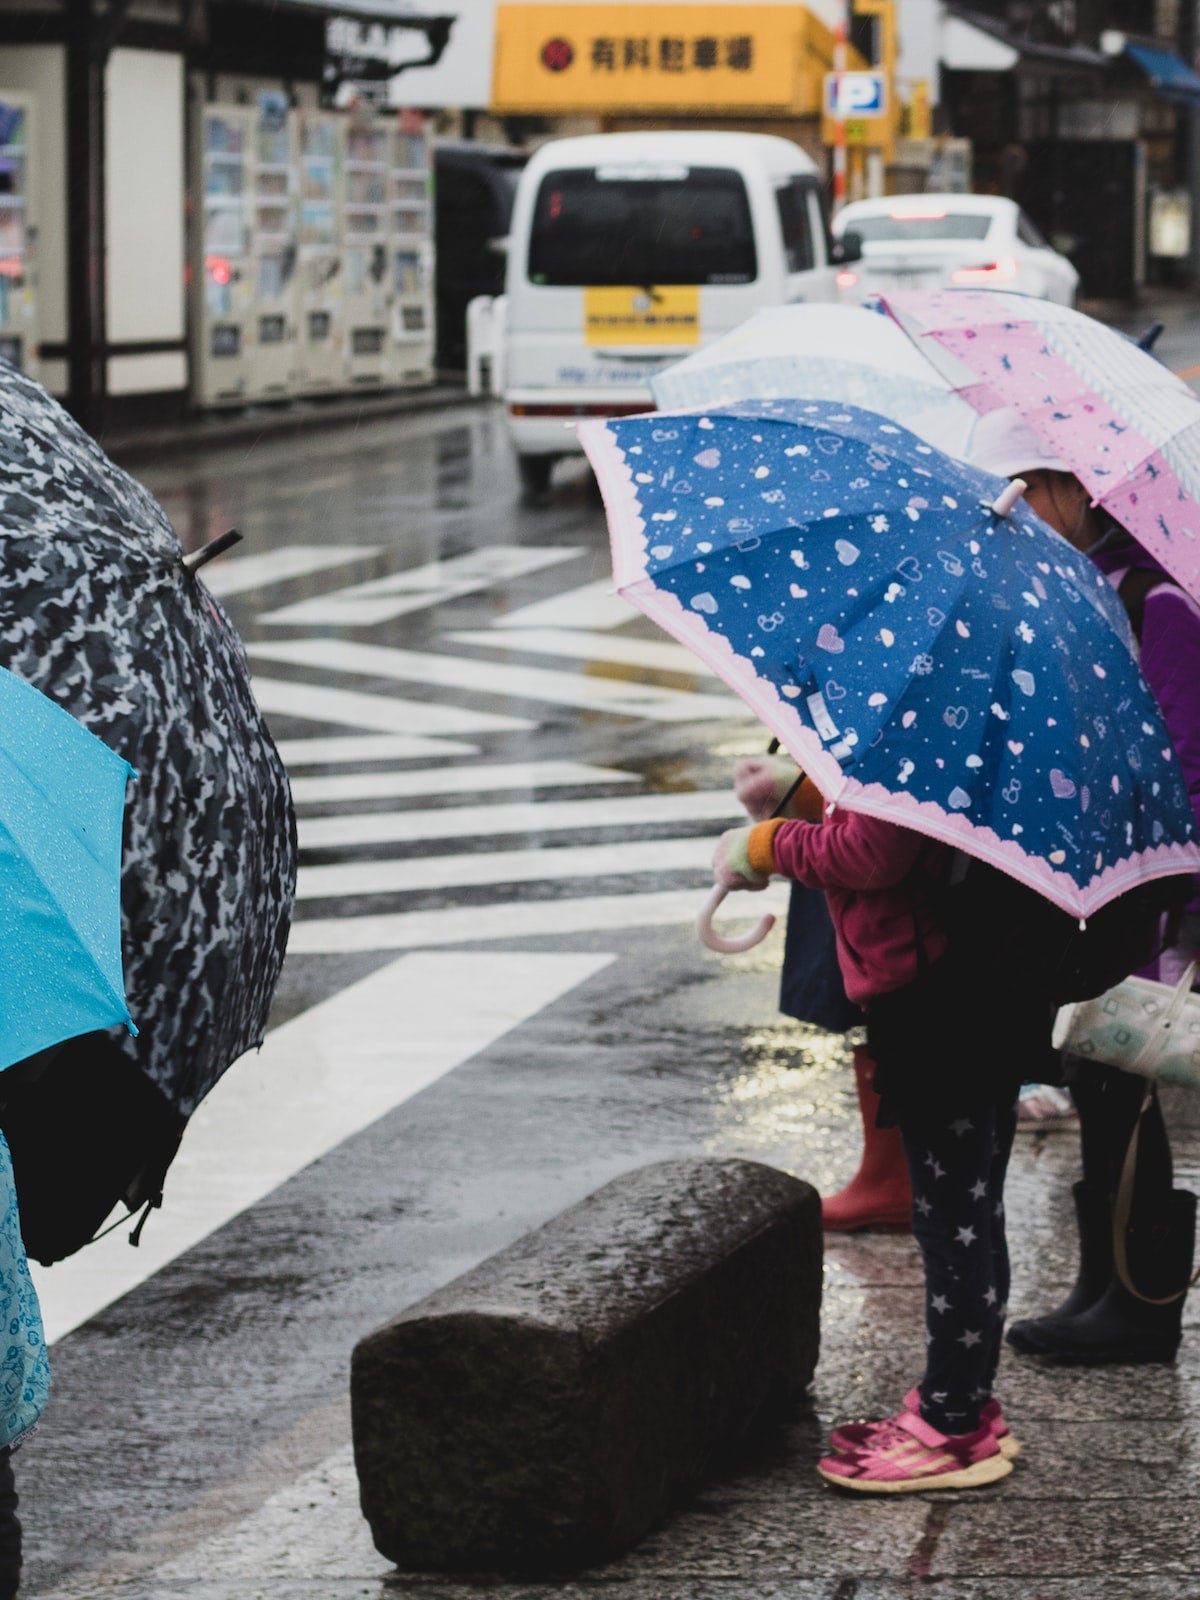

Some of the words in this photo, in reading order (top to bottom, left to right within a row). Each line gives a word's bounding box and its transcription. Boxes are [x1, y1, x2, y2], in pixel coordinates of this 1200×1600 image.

[593, 37, 752, 72] 有料駐車場
[838, 77, 876, 114] P
